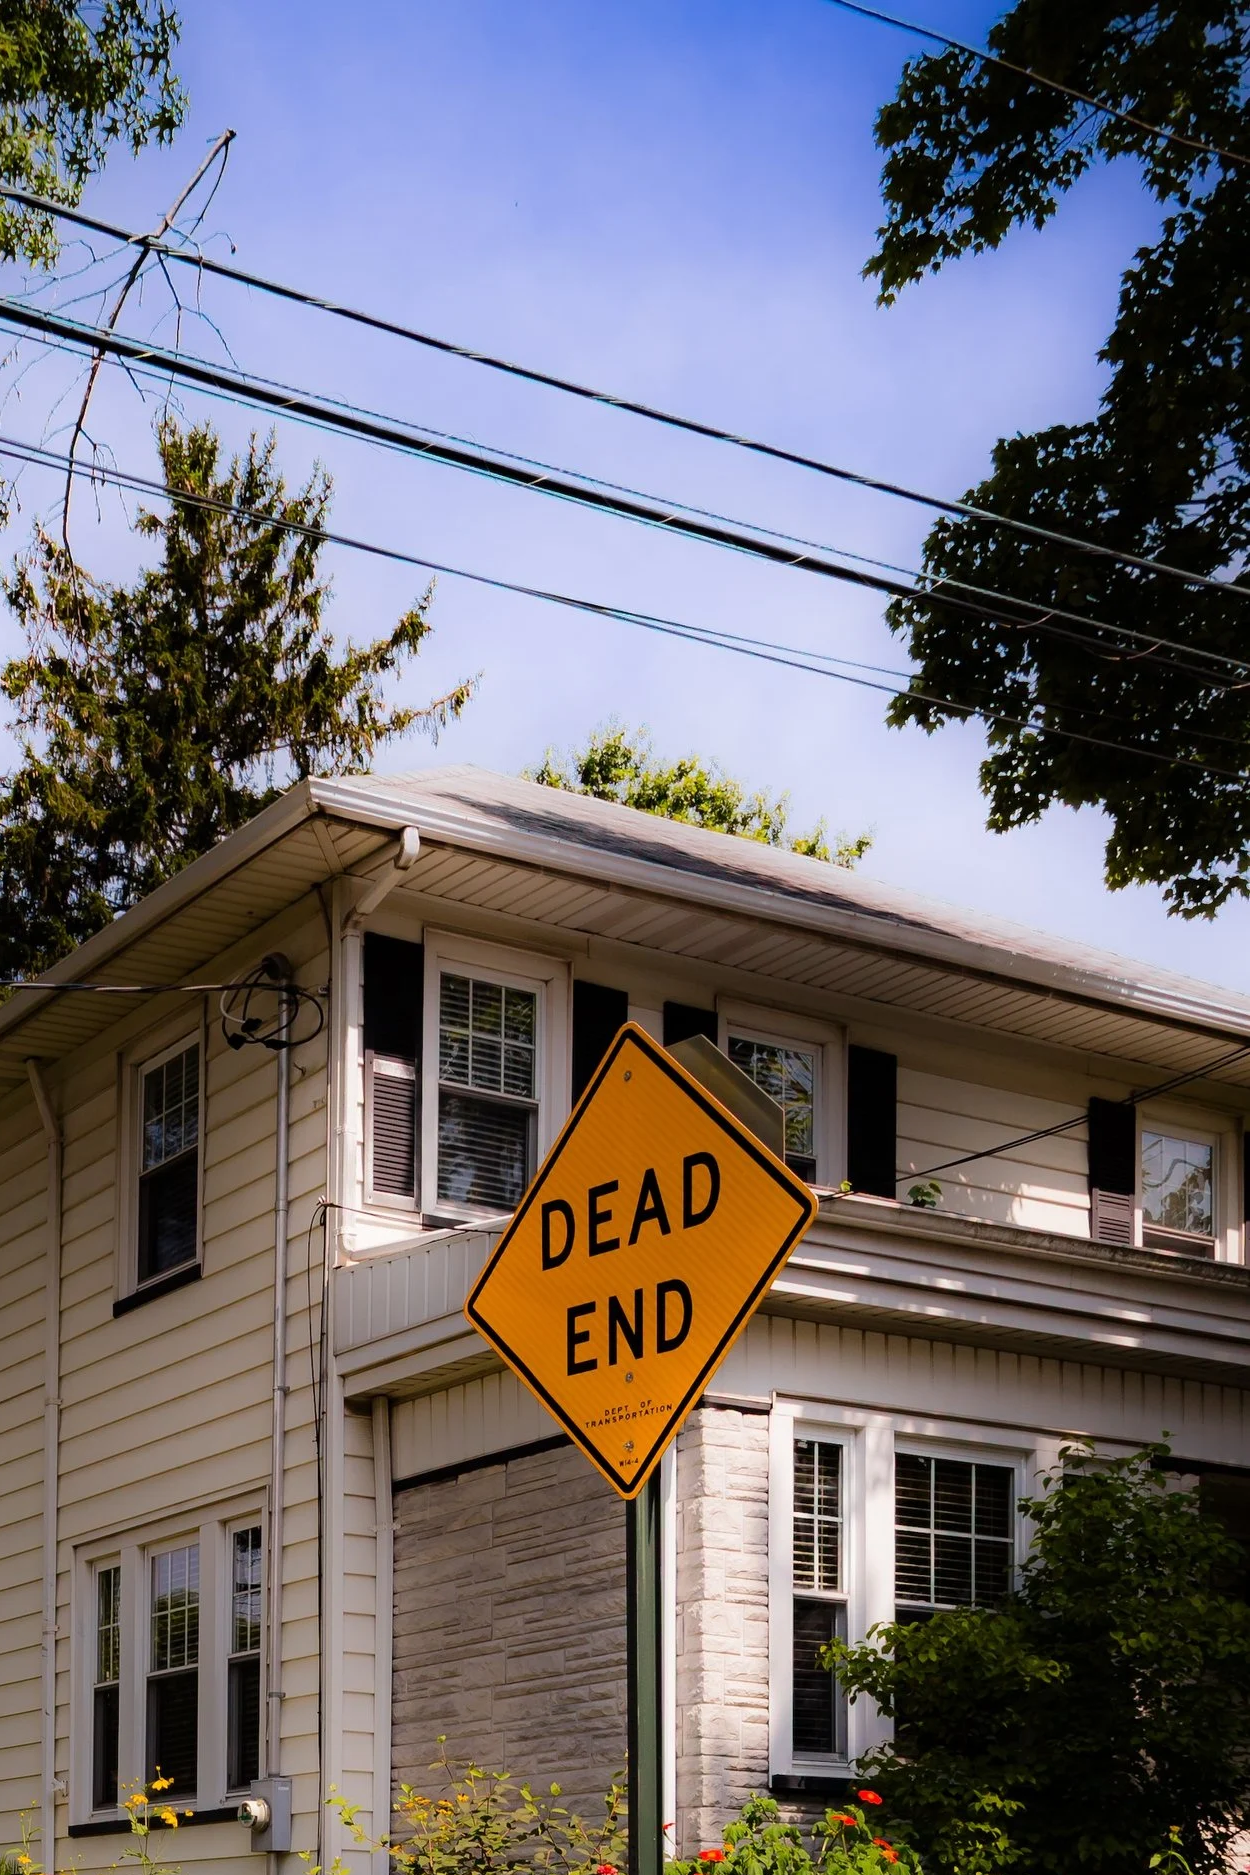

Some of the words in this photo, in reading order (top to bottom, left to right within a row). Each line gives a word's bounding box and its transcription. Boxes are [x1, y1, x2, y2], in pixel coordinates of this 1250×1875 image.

[541, 1152, 720, 1271] DEAD
[566, 1279, 693, 1376] END
[585, 1404, 673, 1428] TRANSPORTATION
[604, 1405, 629, 1416] DEPT
[640, 1400, 653, 1408] OF
